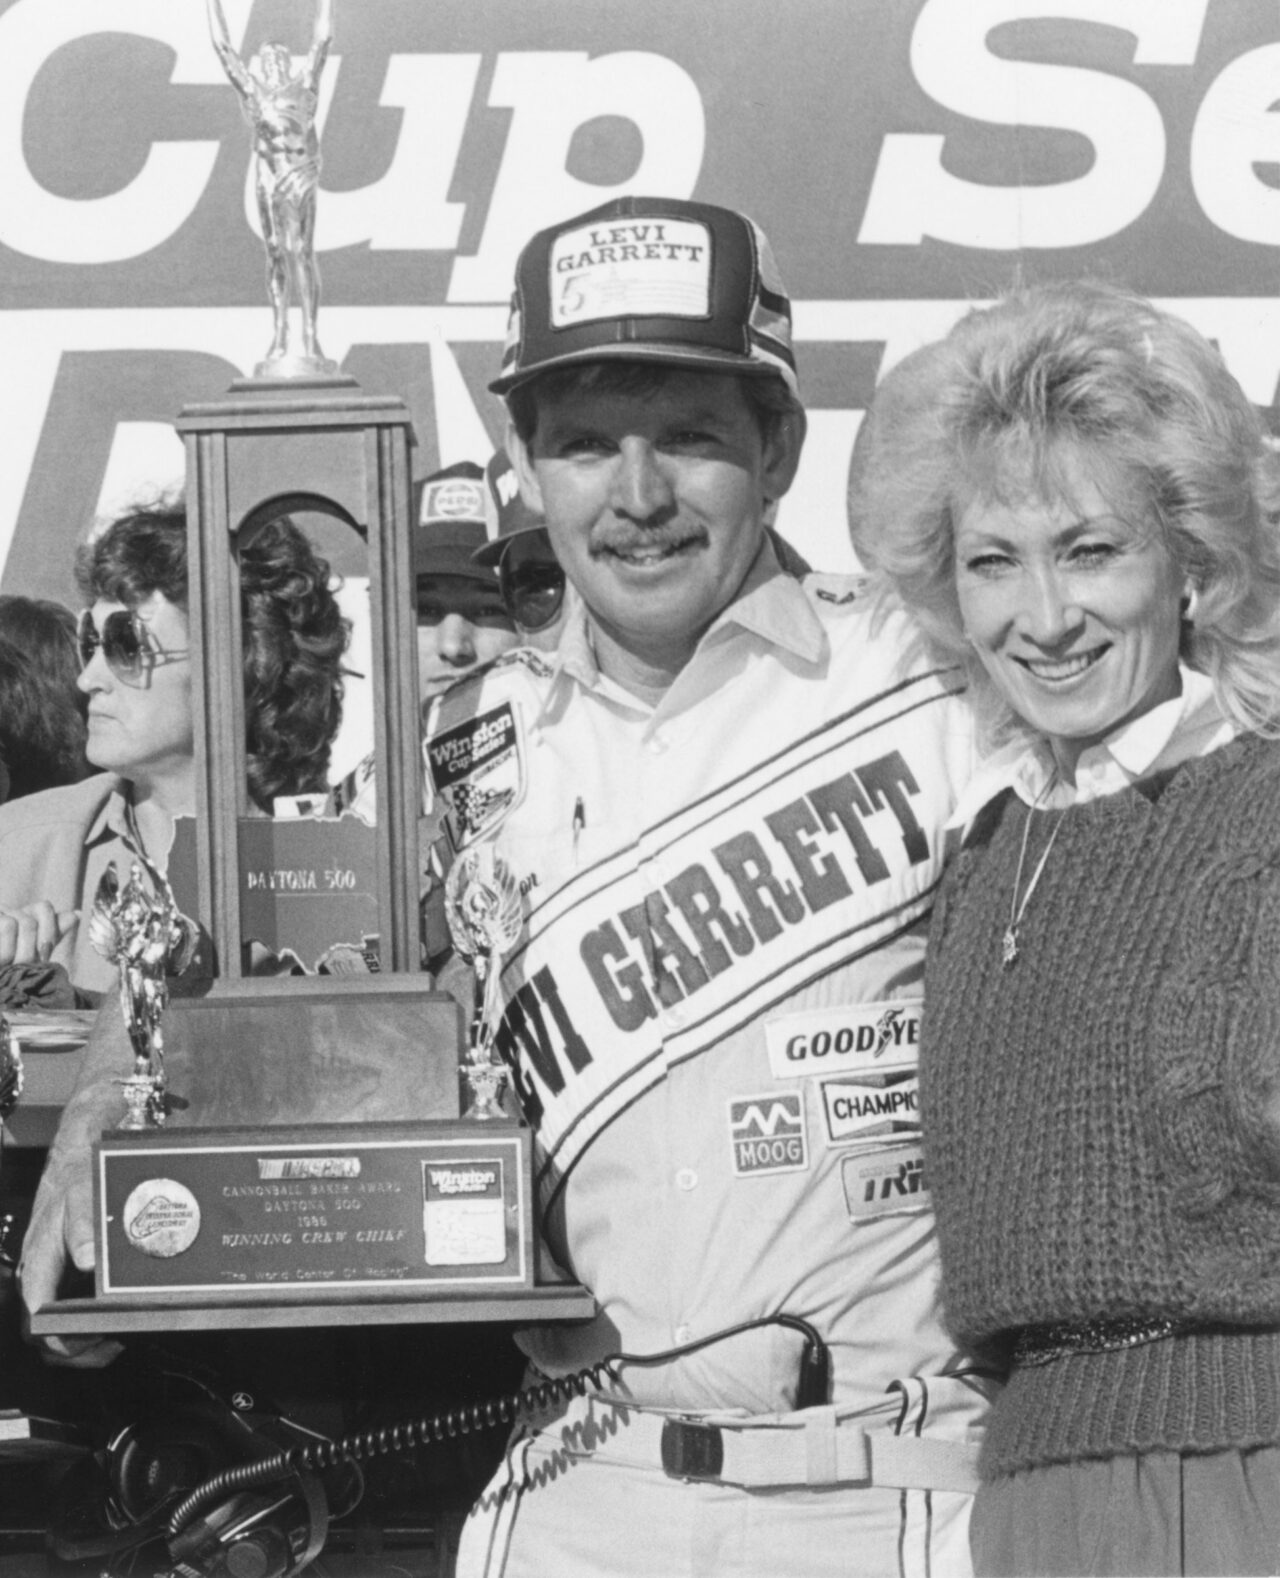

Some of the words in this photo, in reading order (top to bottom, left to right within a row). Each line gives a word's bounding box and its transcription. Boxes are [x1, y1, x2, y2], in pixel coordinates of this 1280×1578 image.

[589, 225, 666, 248] LEVI
[556, 243, 704, 273] GARRETT
[431, 713, 513, 766] Winston
[247, 870, 318, 890] DAYTONA
[324, 869, 357, 889] 500
[494, 962, 594, 1131] EVI
[579, 749, 930, 1033] GARRETT
[785, 1017, 919, 1061] GOODYE
[832, 1089, 919, 1121] CHAMPIO
[739, 1140, 802, 1168] MOOG
